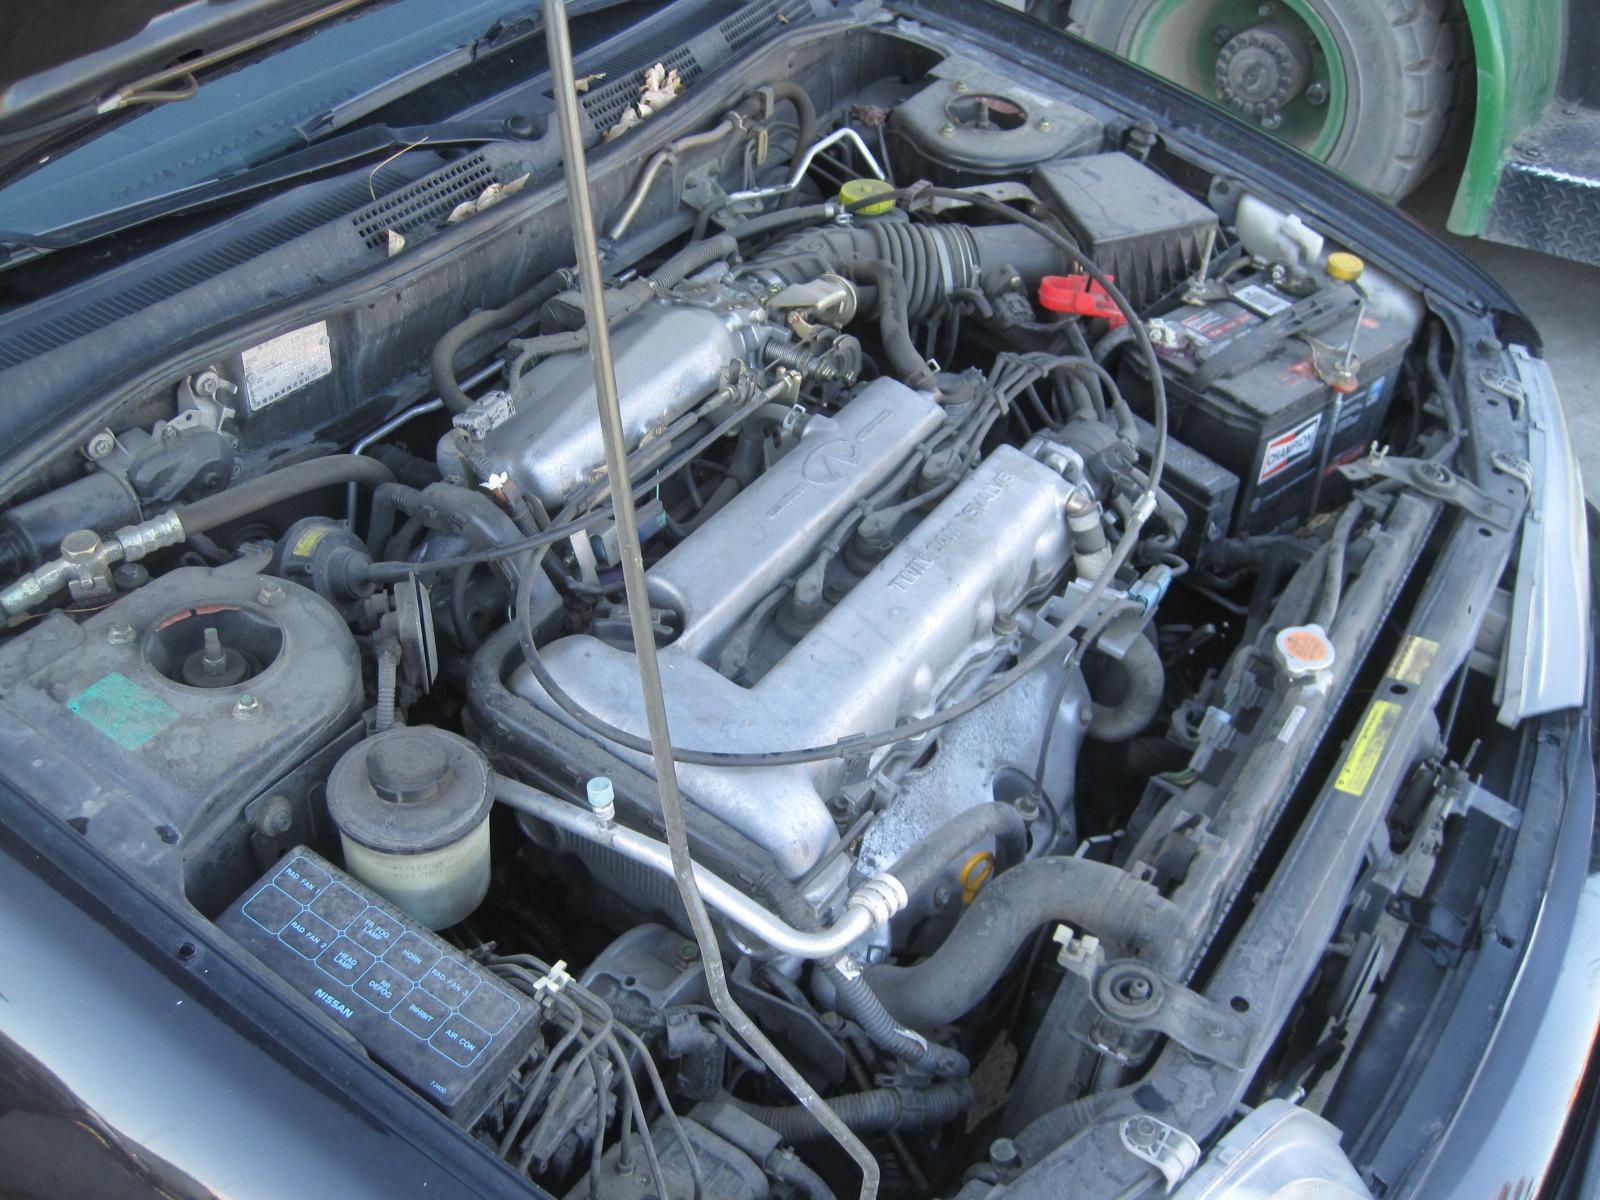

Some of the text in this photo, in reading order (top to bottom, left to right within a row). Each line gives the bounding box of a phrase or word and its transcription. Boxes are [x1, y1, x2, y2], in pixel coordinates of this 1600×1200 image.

[887, 552, 936, 593] TWIN
[284, 867, 300, 881] RAD
[300, 878, 316, 891] FAN
[290, 921, 306, 934] RAD
[306, 932, 321, 945] FAN
[374, 926, 391, 939] FOG
[333, 955, 353, 970] LAMP
[338, 950, 358, 966] HEAD
[402, 948, 422, 965] HORN
[368, 980, 393, 999] DEFOG
[379, 980, 391, 989] RR
[431, 968, 446, 981] RAD
[447, 979, 463, 992] FAN
[314, 988, 354, 1018] NISSAN
[408, 1003, 434, 1022] INHIBIT
[445, 1029, 476, 1052] AIR CON
